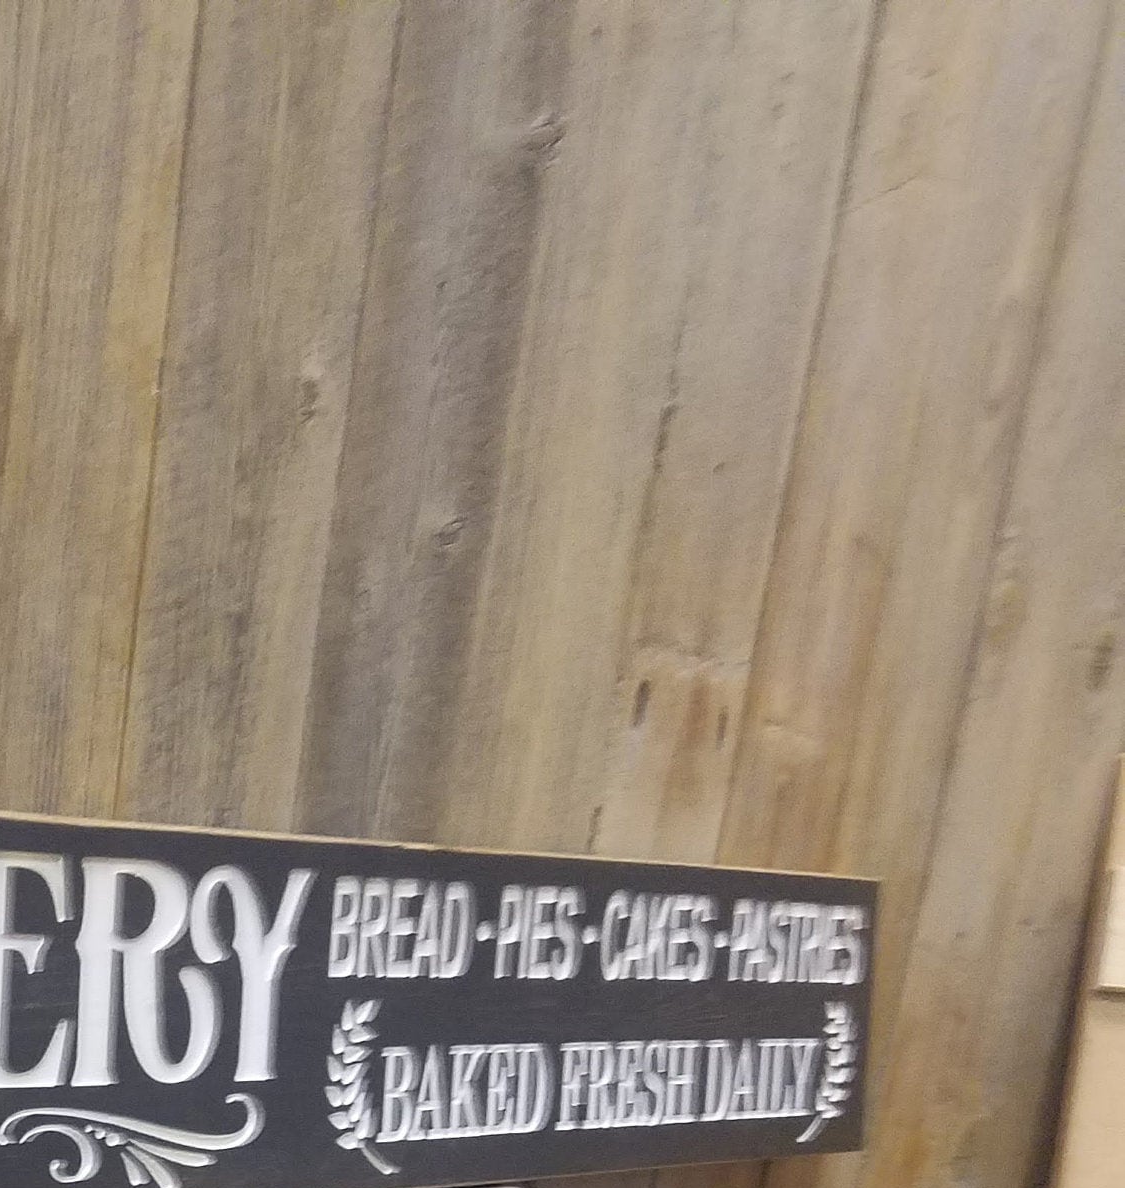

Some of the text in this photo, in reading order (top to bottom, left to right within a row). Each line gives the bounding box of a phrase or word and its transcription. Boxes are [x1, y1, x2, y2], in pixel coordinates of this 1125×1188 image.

[328, 876, 868, 985] BREAD PIES CAKES PASTRIES
[375, 1037, 821, 1143] BAKED FRESH DAILY
